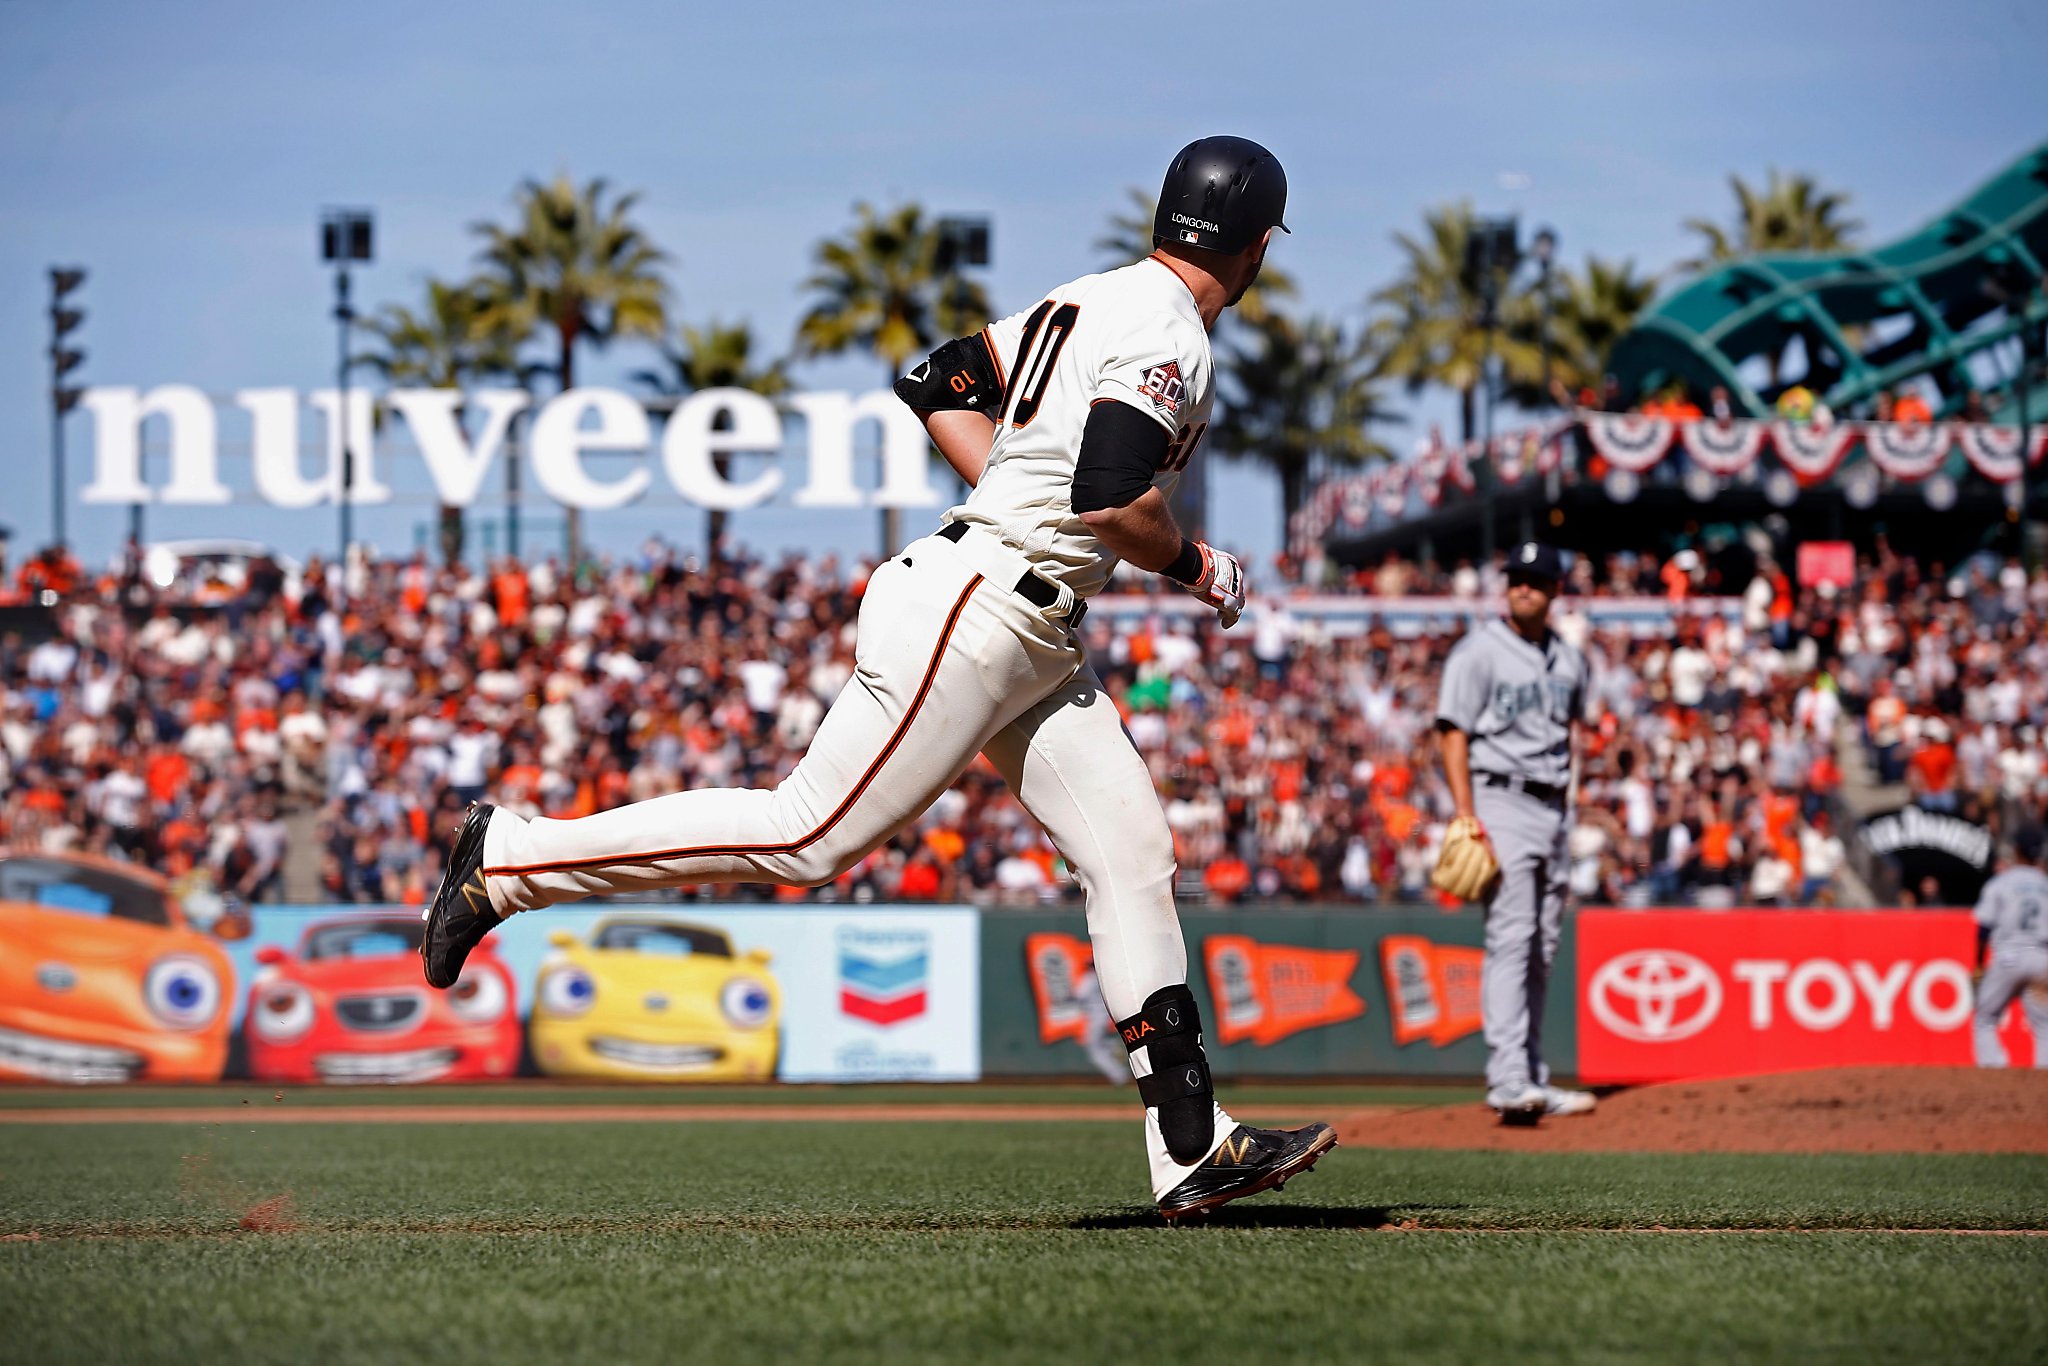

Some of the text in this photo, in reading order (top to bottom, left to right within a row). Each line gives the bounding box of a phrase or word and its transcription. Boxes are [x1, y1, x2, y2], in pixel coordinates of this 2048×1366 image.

[1171, 212, 1219, 233] LONGORIA
[997, 299, 1080, 429] 10
[80, 384, 942, 510] nuveen
[1732, 959, 1978, 1031] TOYO
[1121, 1020, 1156, 1044] RIA
